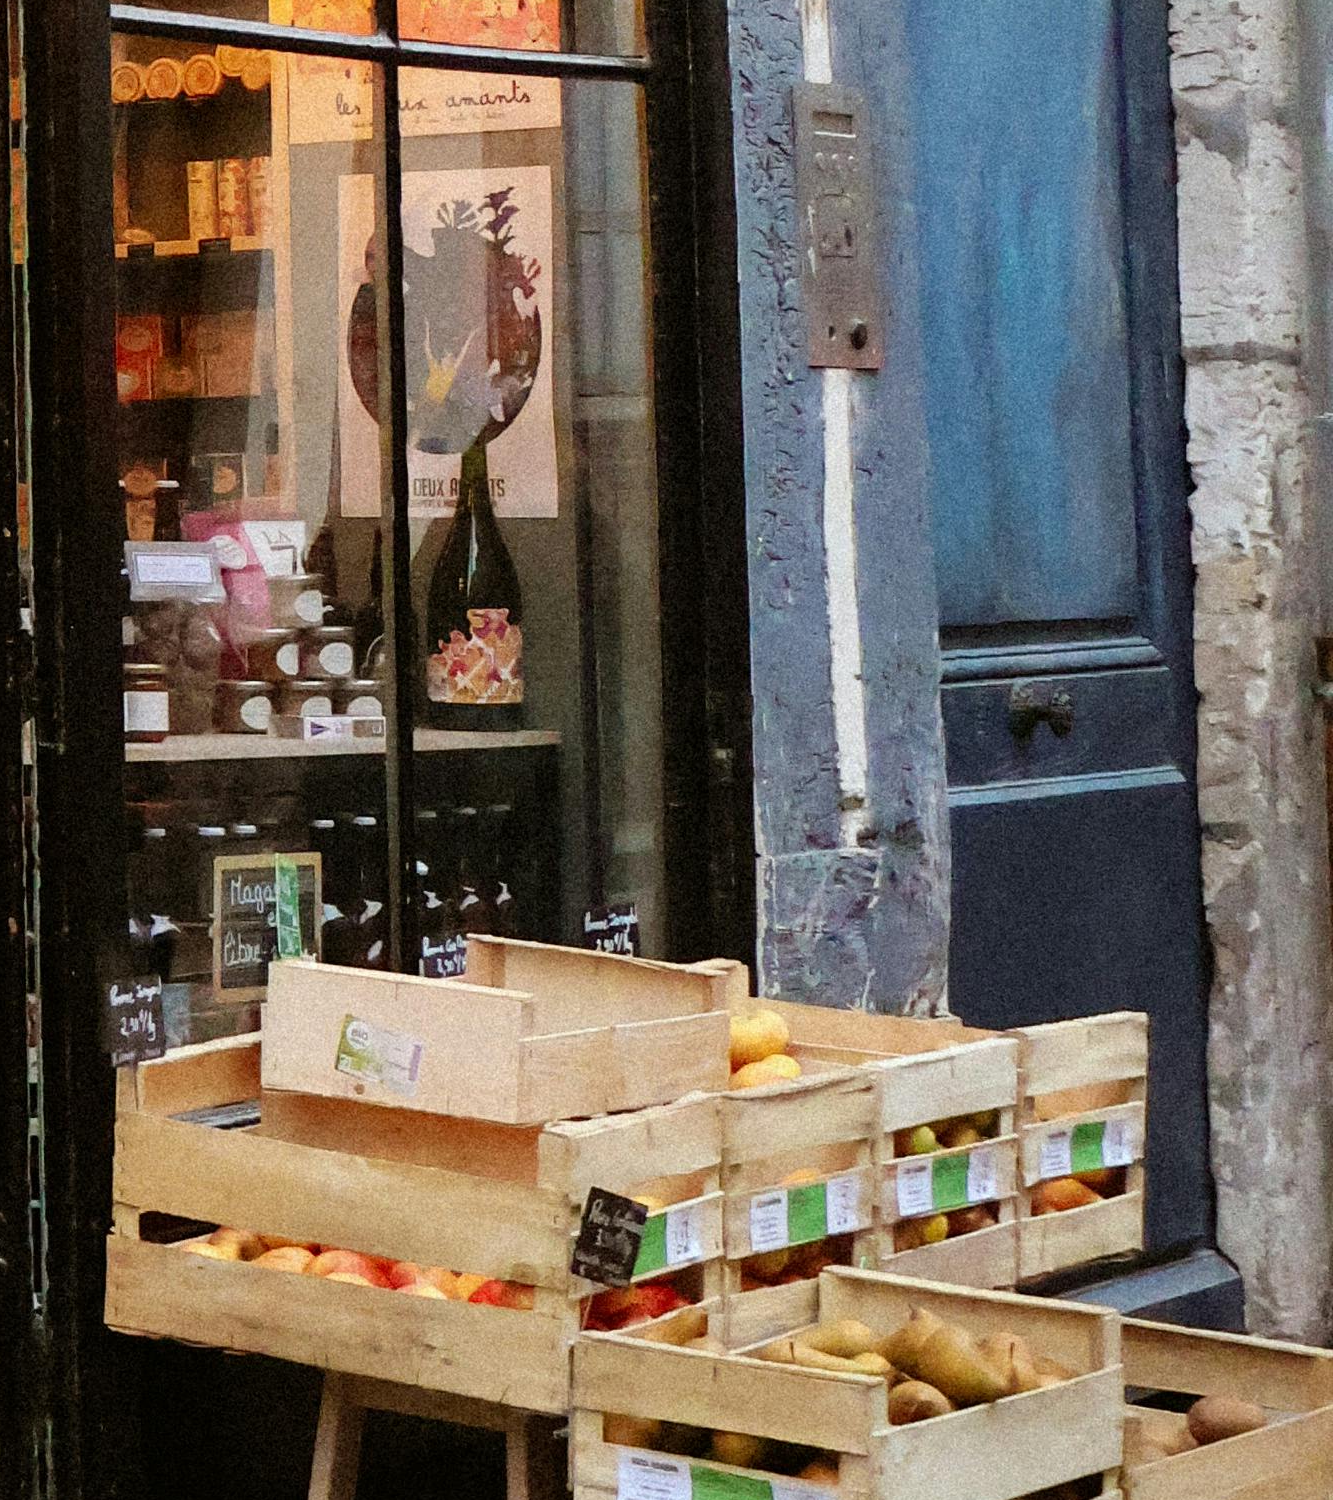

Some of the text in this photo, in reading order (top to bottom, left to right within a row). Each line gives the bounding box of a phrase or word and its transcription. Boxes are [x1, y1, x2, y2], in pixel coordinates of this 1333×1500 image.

[445, 79, 533, 108] amants
[413, 476, 506, 498] DEUX ATS
